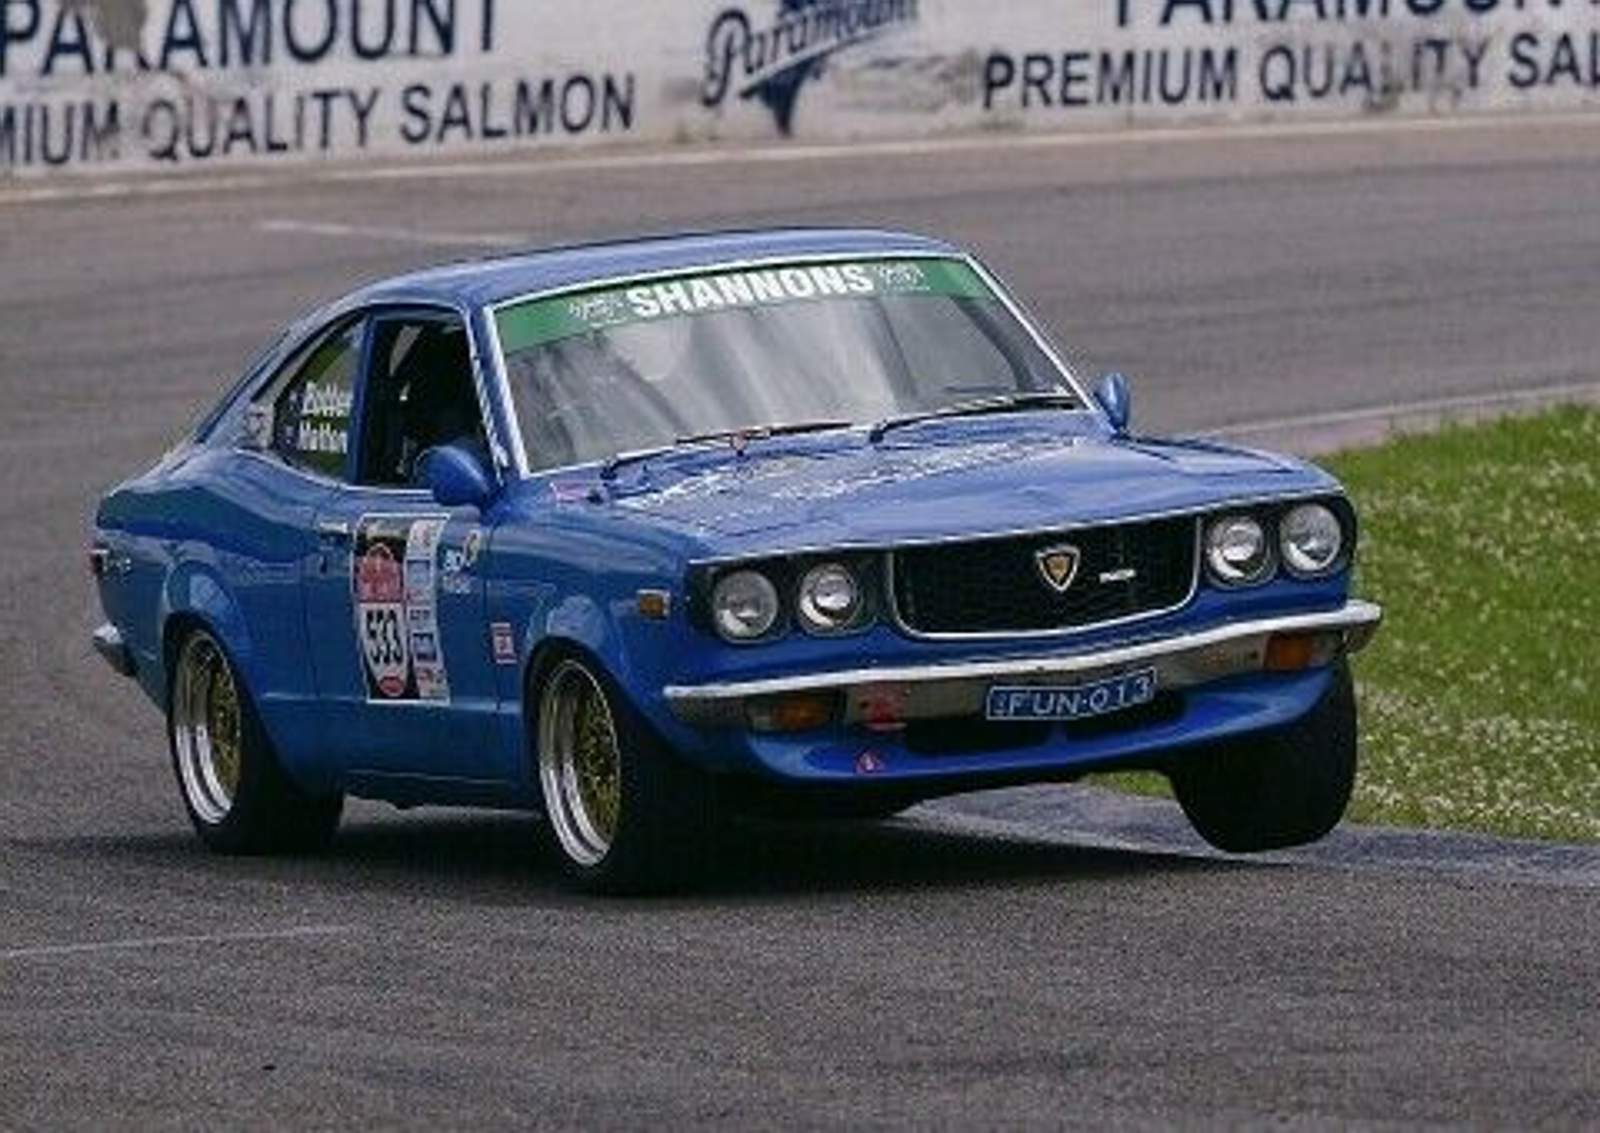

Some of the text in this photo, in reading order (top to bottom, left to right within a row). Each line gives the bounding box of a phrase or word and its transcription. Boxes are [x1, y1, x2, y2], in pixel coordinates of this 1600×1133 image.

[0, 0, 493, 76] PAAMOUNT
[983, 47, 1238, 109] PREMIUM
[1258, 37, 1492, 102] QUALITY
[142, 86, 379, 161] QUALITY
[400, 73, 634, 145] SALMON
[626, 264, 874, 317] SHANNONS
